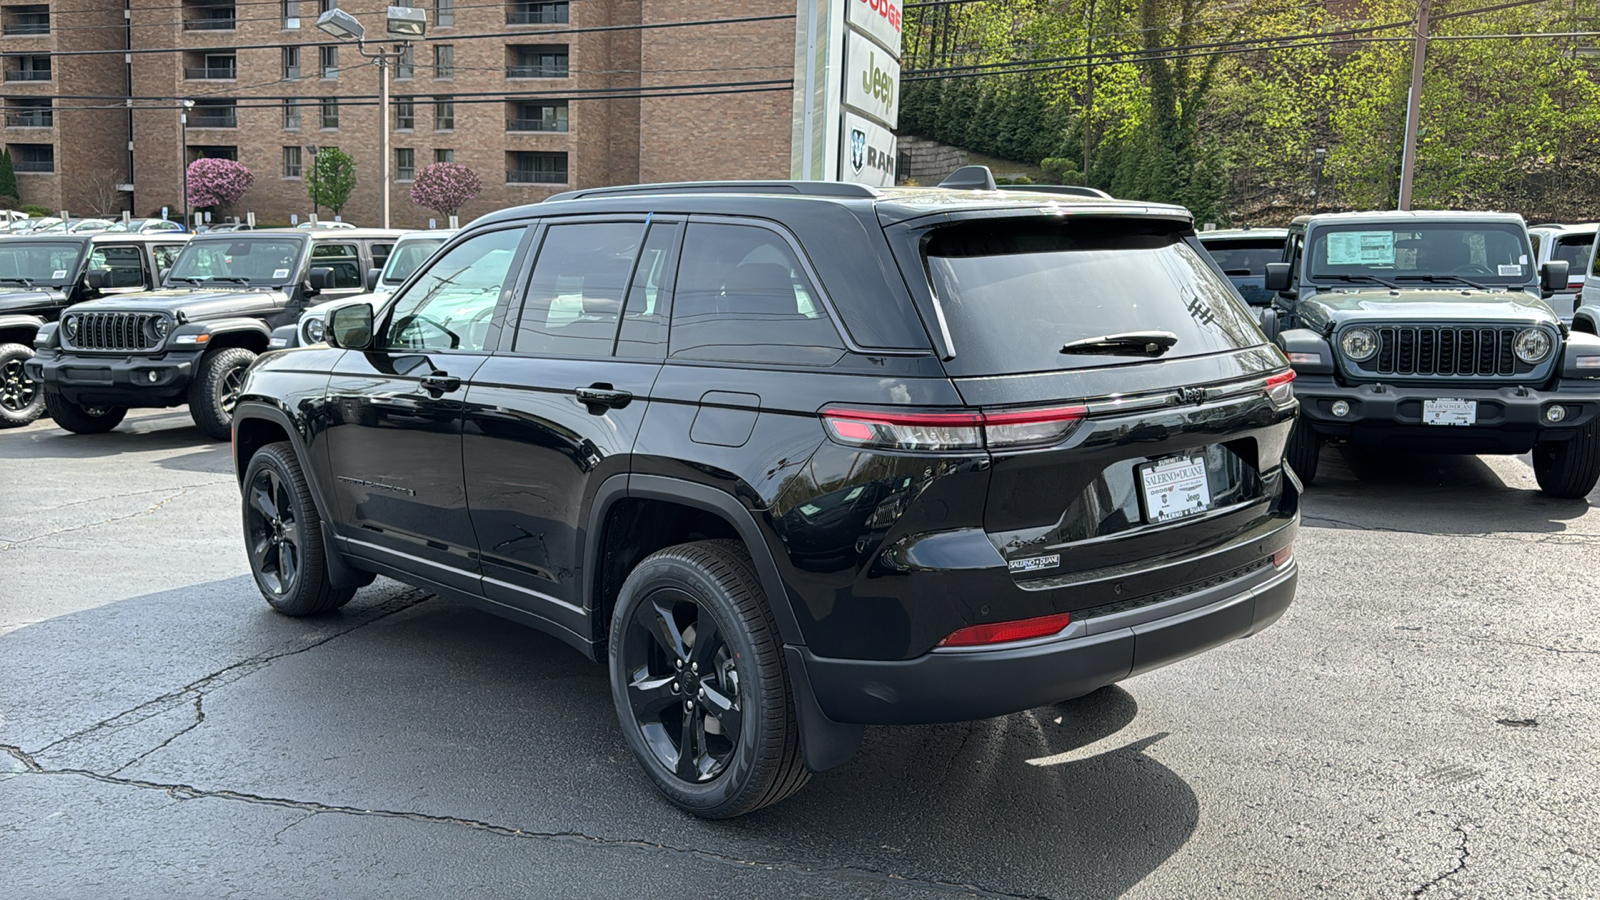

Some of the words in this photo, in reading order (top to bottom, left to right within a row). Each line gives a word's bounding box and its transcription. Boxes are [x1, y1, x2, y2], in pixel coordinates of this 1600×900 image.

[858, 0, 901, 33] ODGE
[863, 51, 894, 115] Jeep
[867, 145, 894, 176] RAM
[1177, 386, 1208, 406] Jeep
[1145, 471, 1177, 487] SALERNO
[1179, 465, 1204, 479] DUANE
[1186, 493, 1201, 502] Jeep
